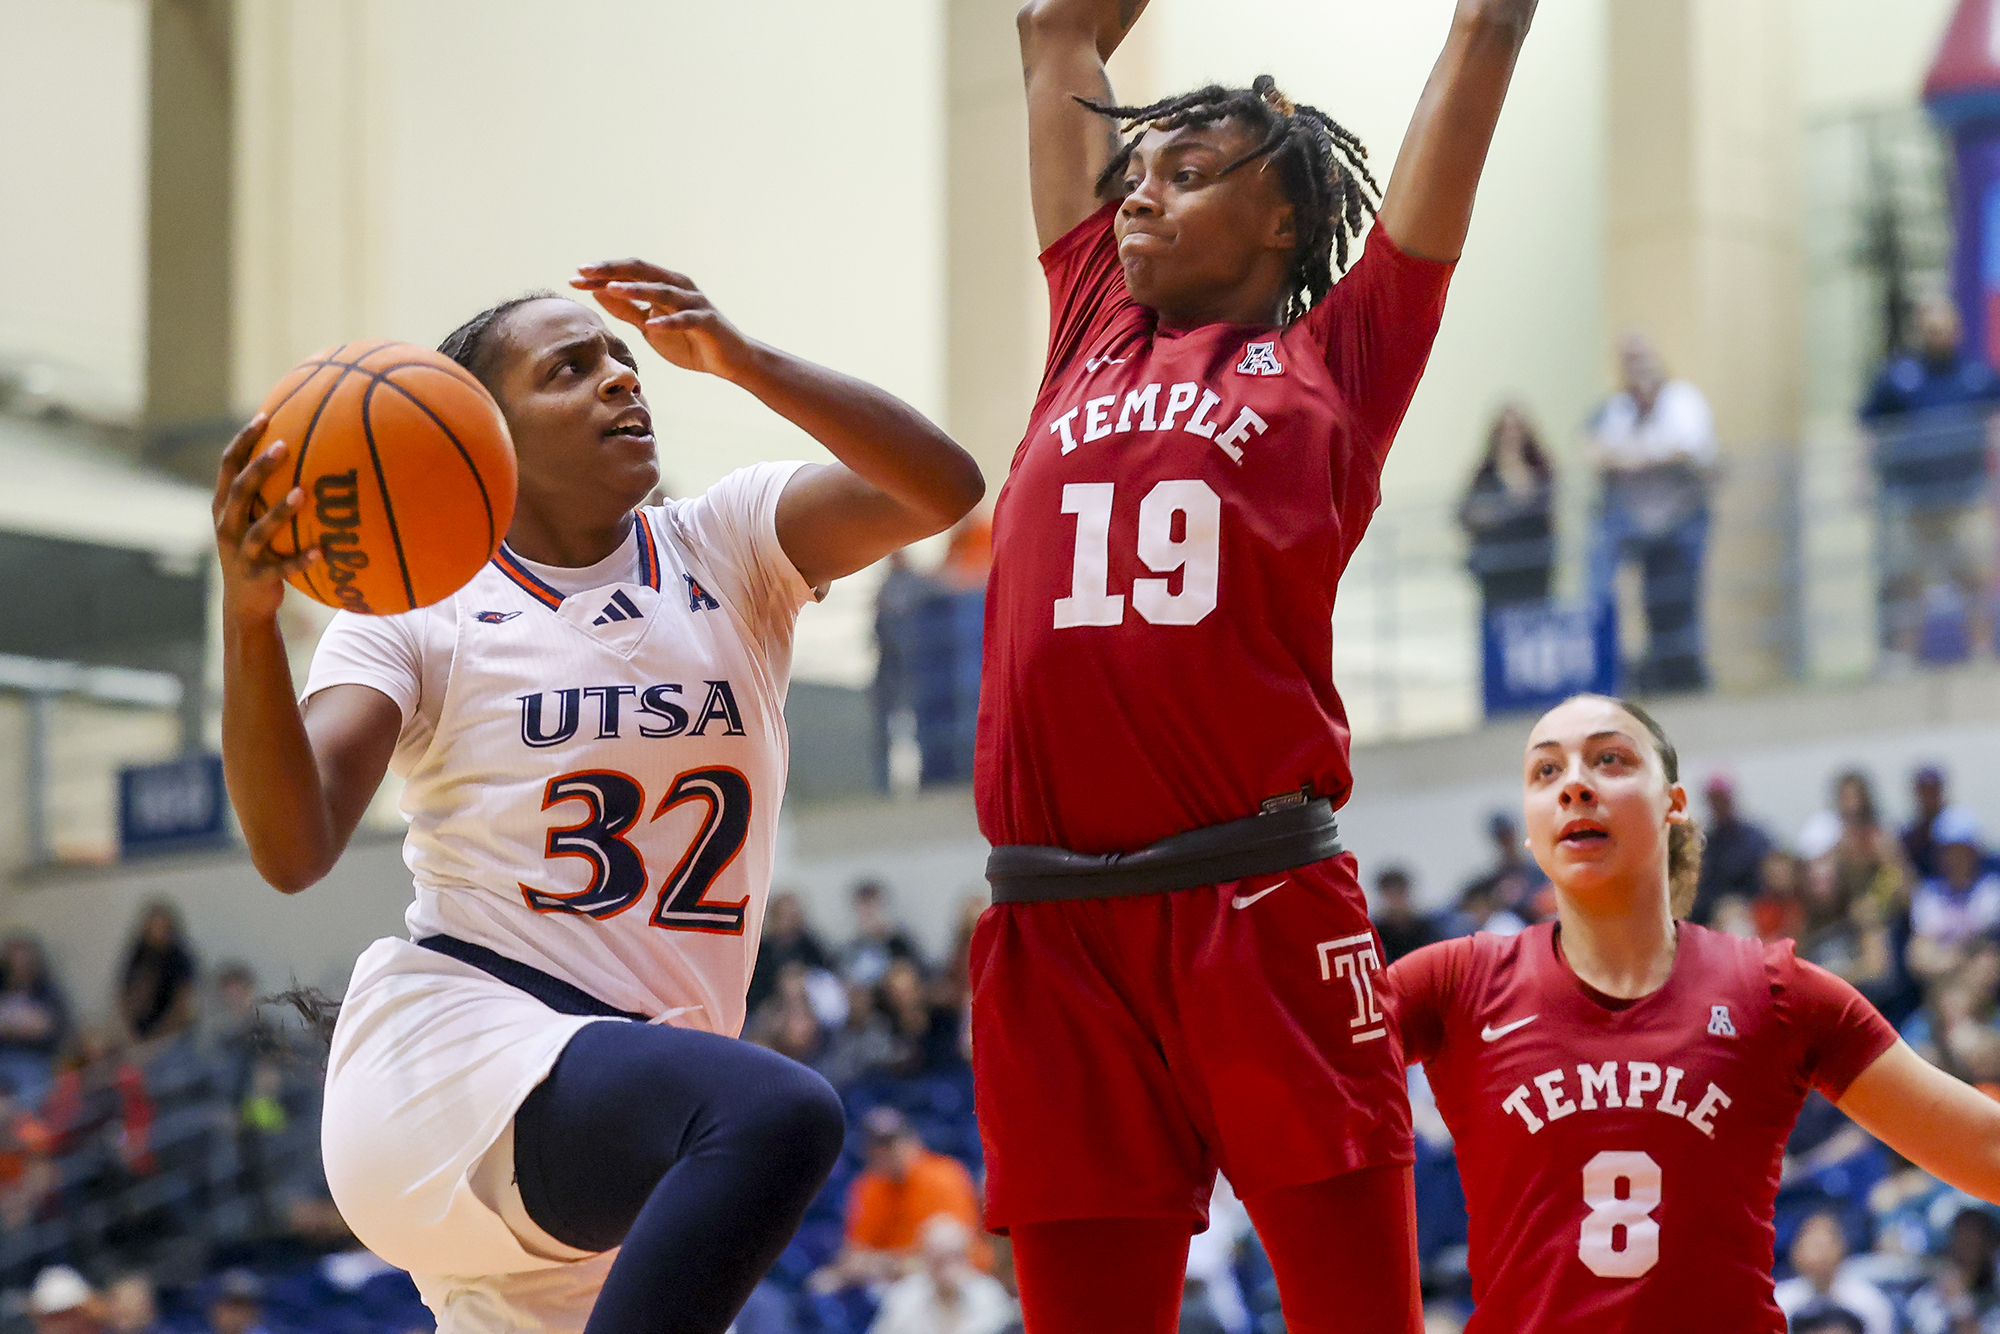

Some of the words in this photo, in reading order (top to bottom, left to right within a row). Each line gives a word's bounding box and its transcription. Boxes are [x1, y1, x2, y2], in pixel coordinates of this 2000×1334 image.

[1050, 381, 1269, 463] TEMPLE
[1053, 479, 1221, 629] 19
[516, 680, 747, 748] UTSA
[517, 765, 753, 936] 32
[1501, 1060, 1732, 1137] TEMPLE
[1578, 1150, 1662, 1278] 8
